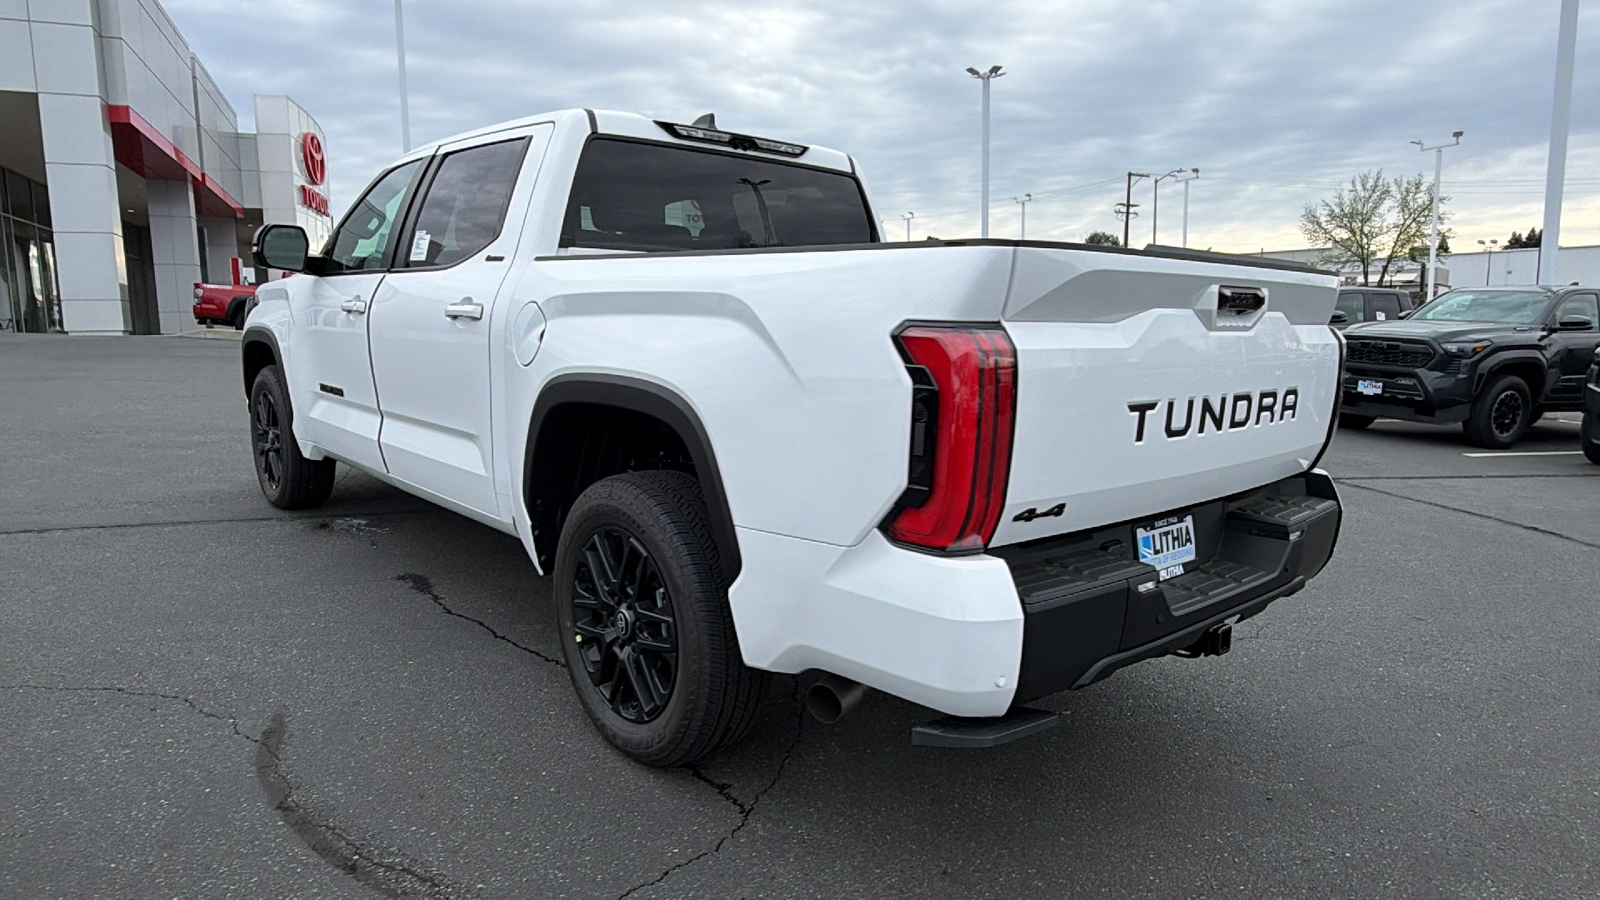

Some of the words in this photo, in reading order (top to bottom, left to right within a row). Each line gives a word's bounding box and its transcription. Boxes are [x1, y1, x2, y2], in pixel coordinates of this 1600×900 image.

[1127, 387, 1299, 443] TUNDRA
[1154, 519, 1168, 528] SINCE
[1151, 525, 1193, 555] LITHIA
[1162, 553, 1170, 564] OF
